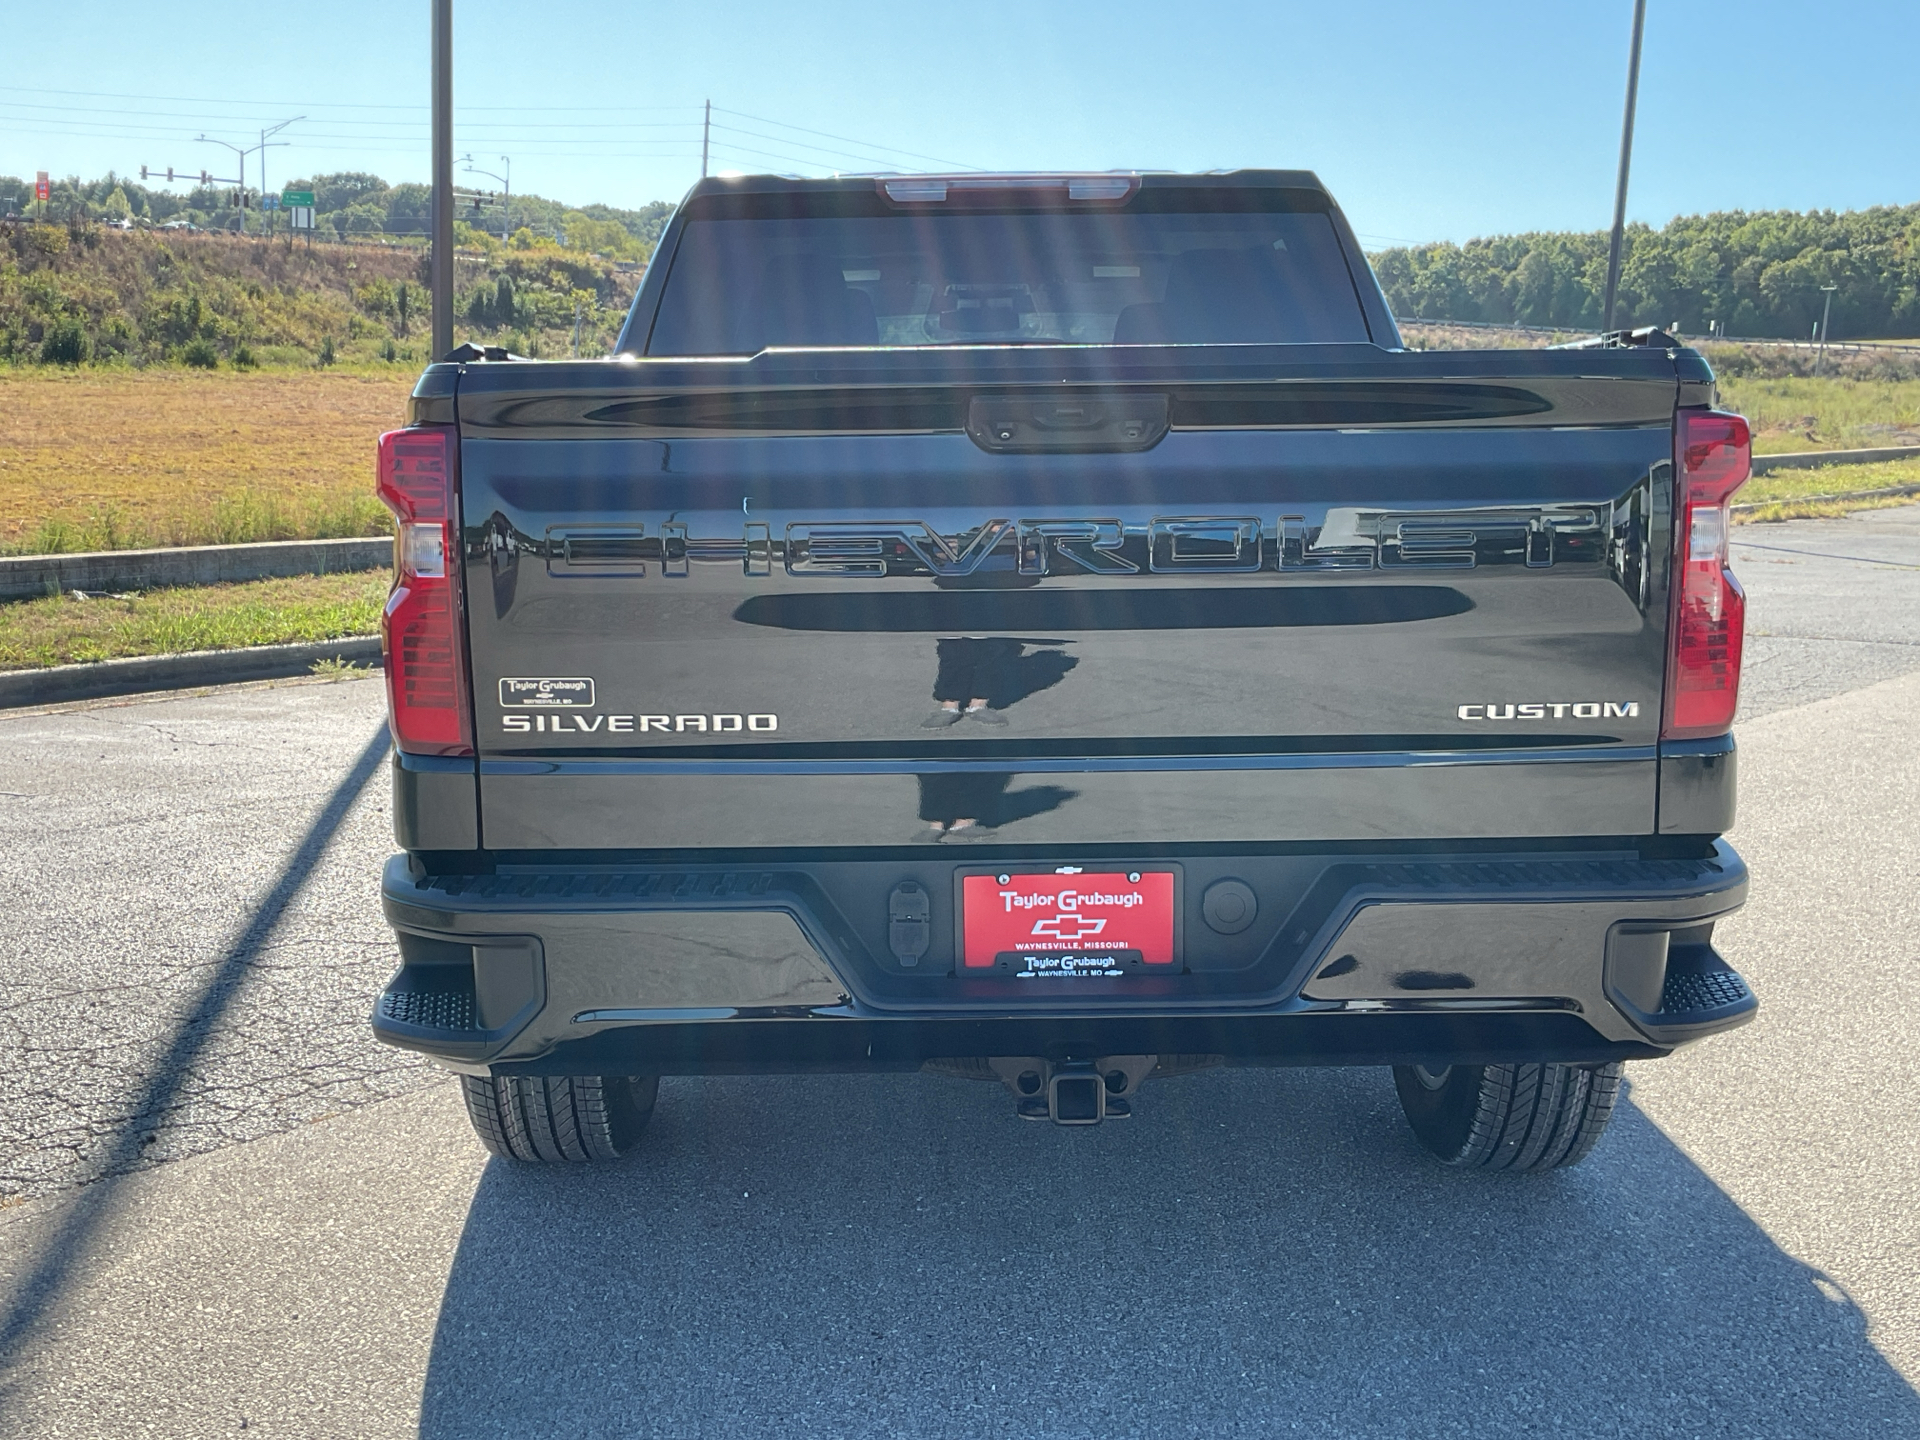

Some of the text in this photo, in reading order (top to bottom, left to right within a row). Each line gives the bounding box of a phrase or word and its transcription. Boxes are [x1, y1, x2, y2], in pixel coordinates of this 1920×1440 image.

[546, 508, 1597, 578] CHEVROLET
[507, 680, 586, 692] Taylor Grubaugh
[1457, 702, 1639, 720] CUSTOM
[502, 714, 778, 732] SILVERADO
[999, 890, 1143, 912] Taylor Grubaugh
[1015, 941, 1129, 950] WAYNESVILLE, MISSOURI
[1024, 955, 1115, 970] Taylor Grubaugh
